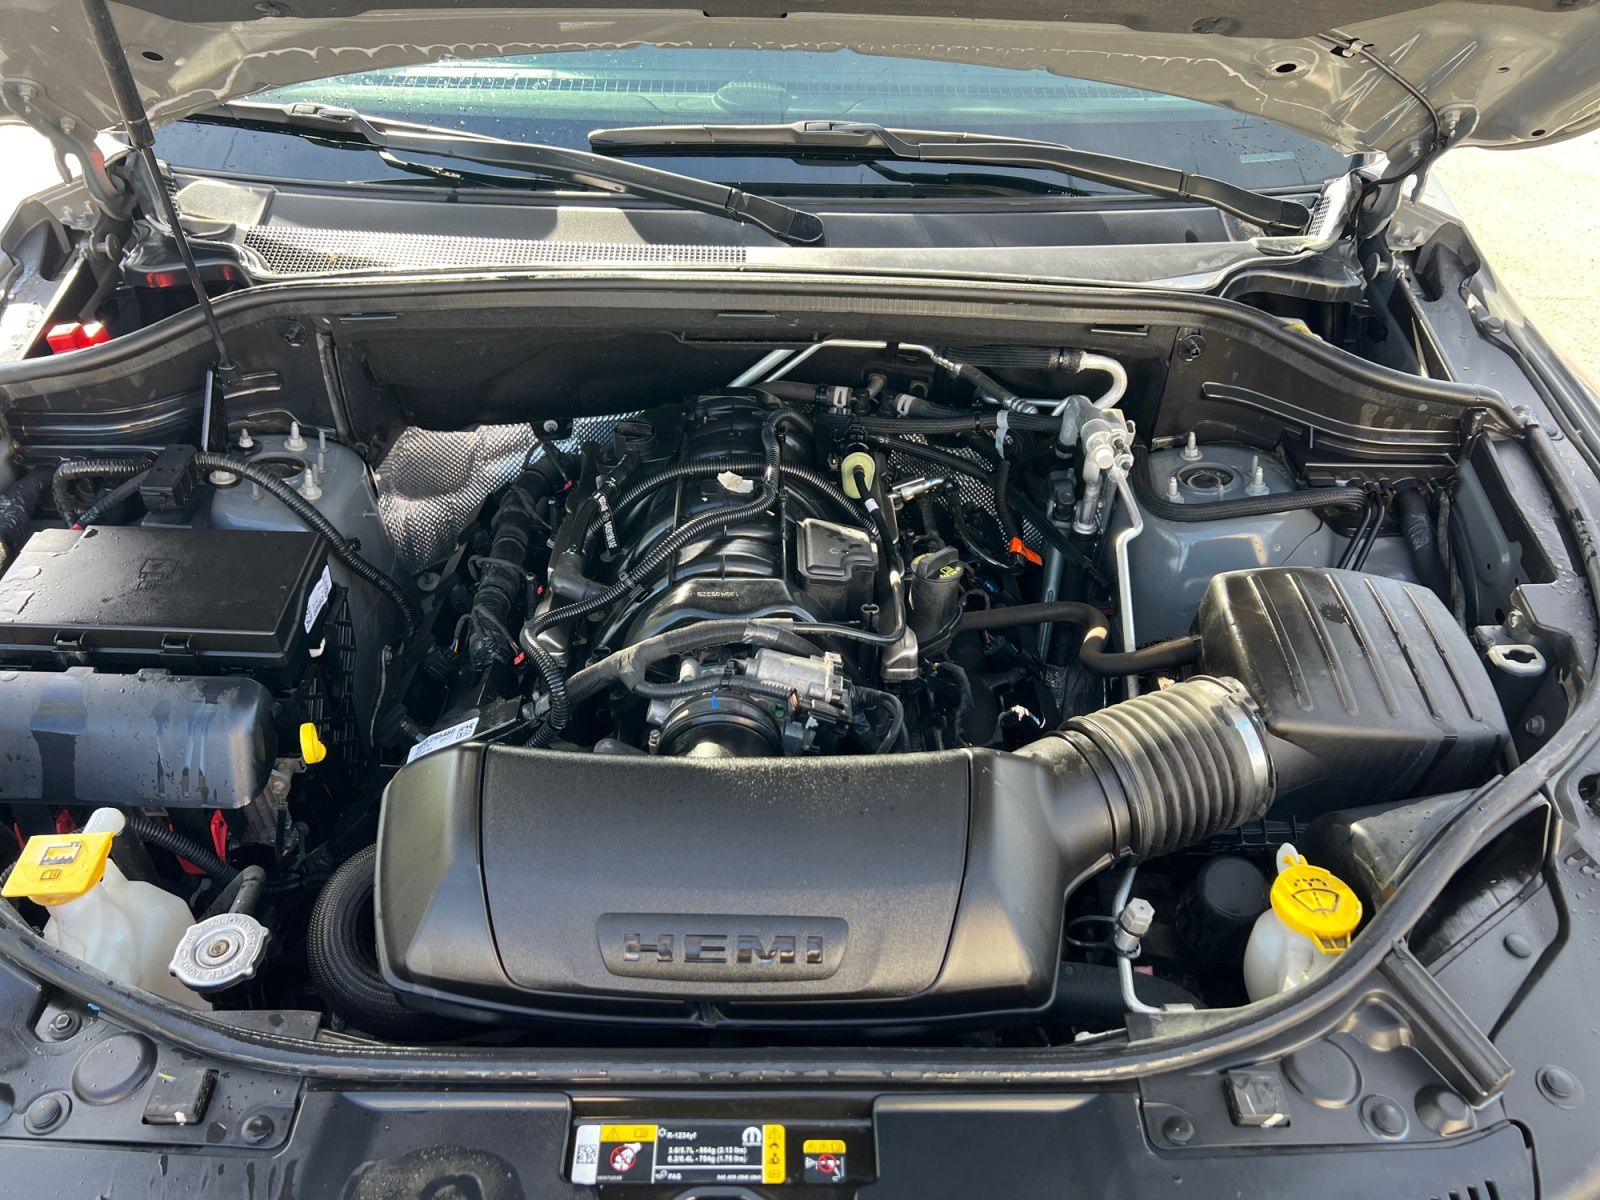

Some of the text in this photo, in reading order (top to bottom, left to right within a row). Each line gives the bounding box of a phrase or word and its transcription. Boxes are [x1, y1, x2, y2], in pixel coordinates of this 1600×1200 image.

[623, 933, 823, 964] HEMI
[666, 1131, 697, 1141] R-1234yf
[733, 1146, 747, 1155] lbs)
[733, 1155, 747, 1163] lbs)
